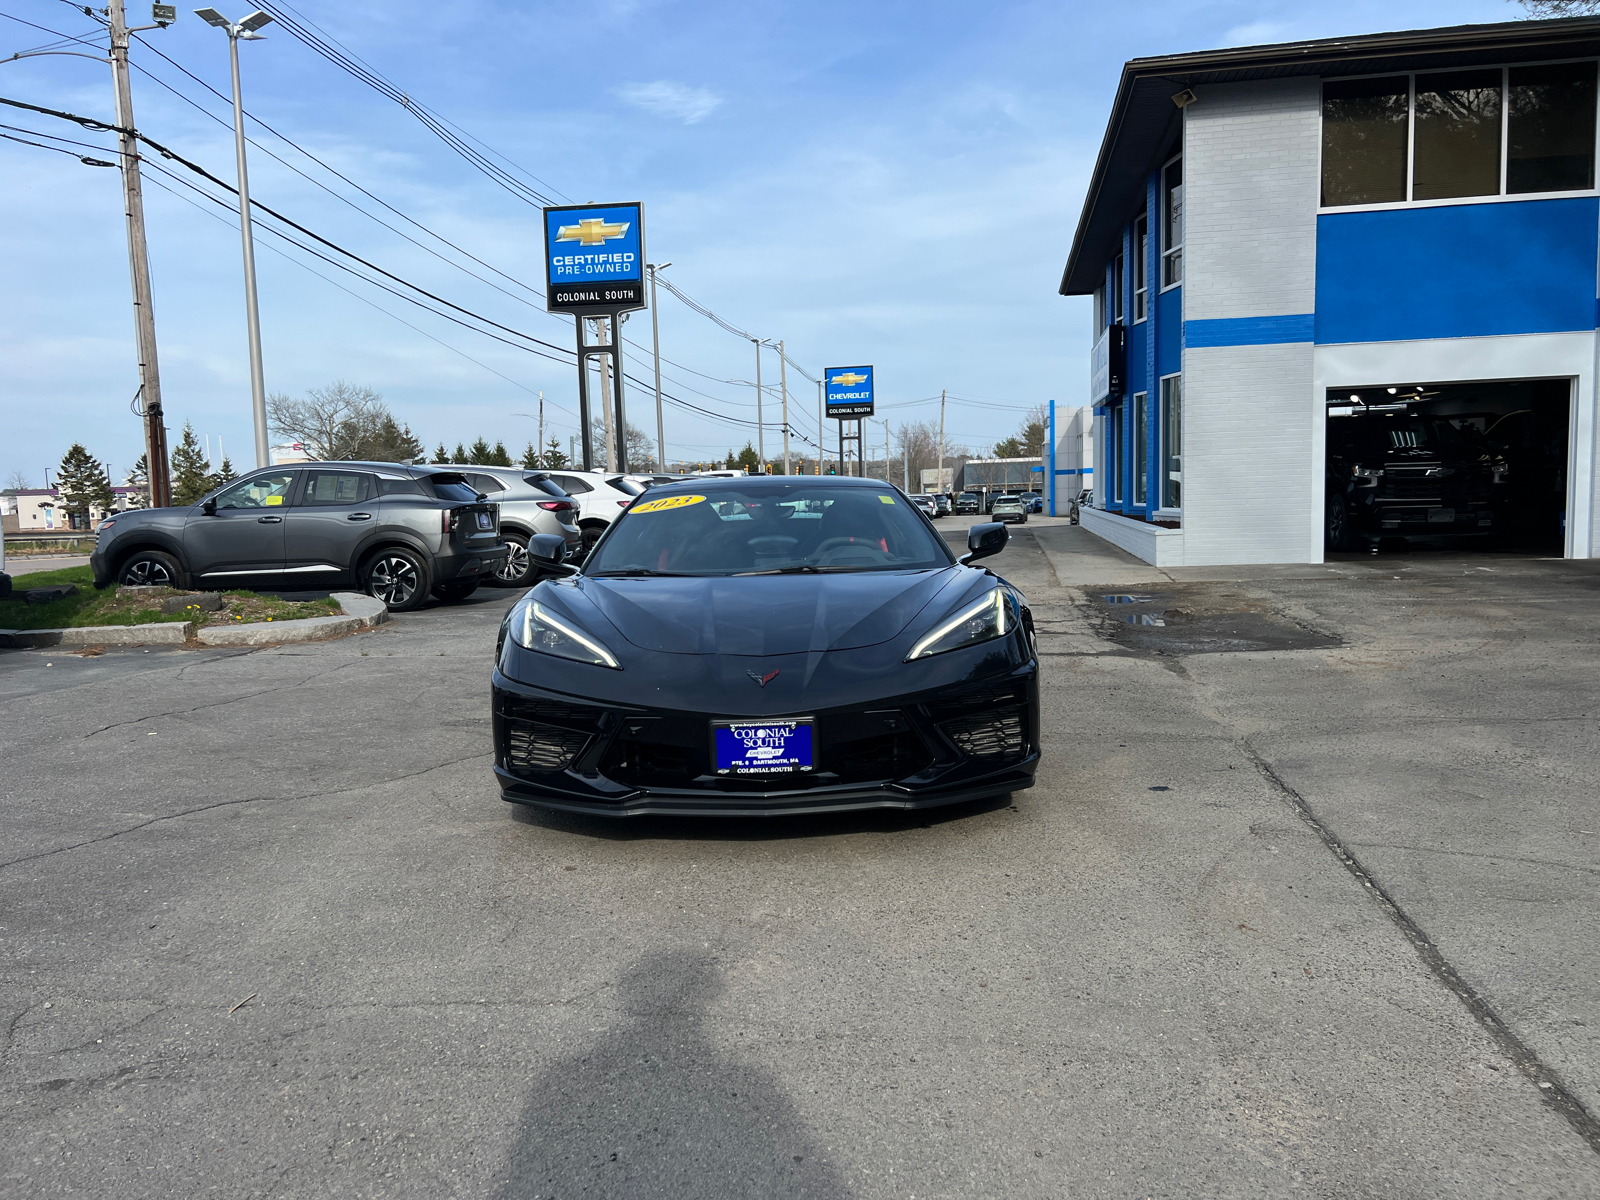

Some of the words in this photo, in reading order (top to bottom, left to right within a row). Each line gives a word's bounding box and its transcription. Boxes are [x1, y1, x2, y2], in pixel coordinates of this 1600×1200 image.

[553, 253, 634, 265] CERTIFIED
[558, 263, 631, 275] PRE-OWNED
[557, 292, 600, 302] COLONIAL
[605, 290, 634, 300] SOUTH
[829, 392, 869, 400] CHEVROLET
[640, 496, 693, 512] 2023
[734, 728, 793, 739] COLONIAL
[744, 737, 785, 748] SOUTH
